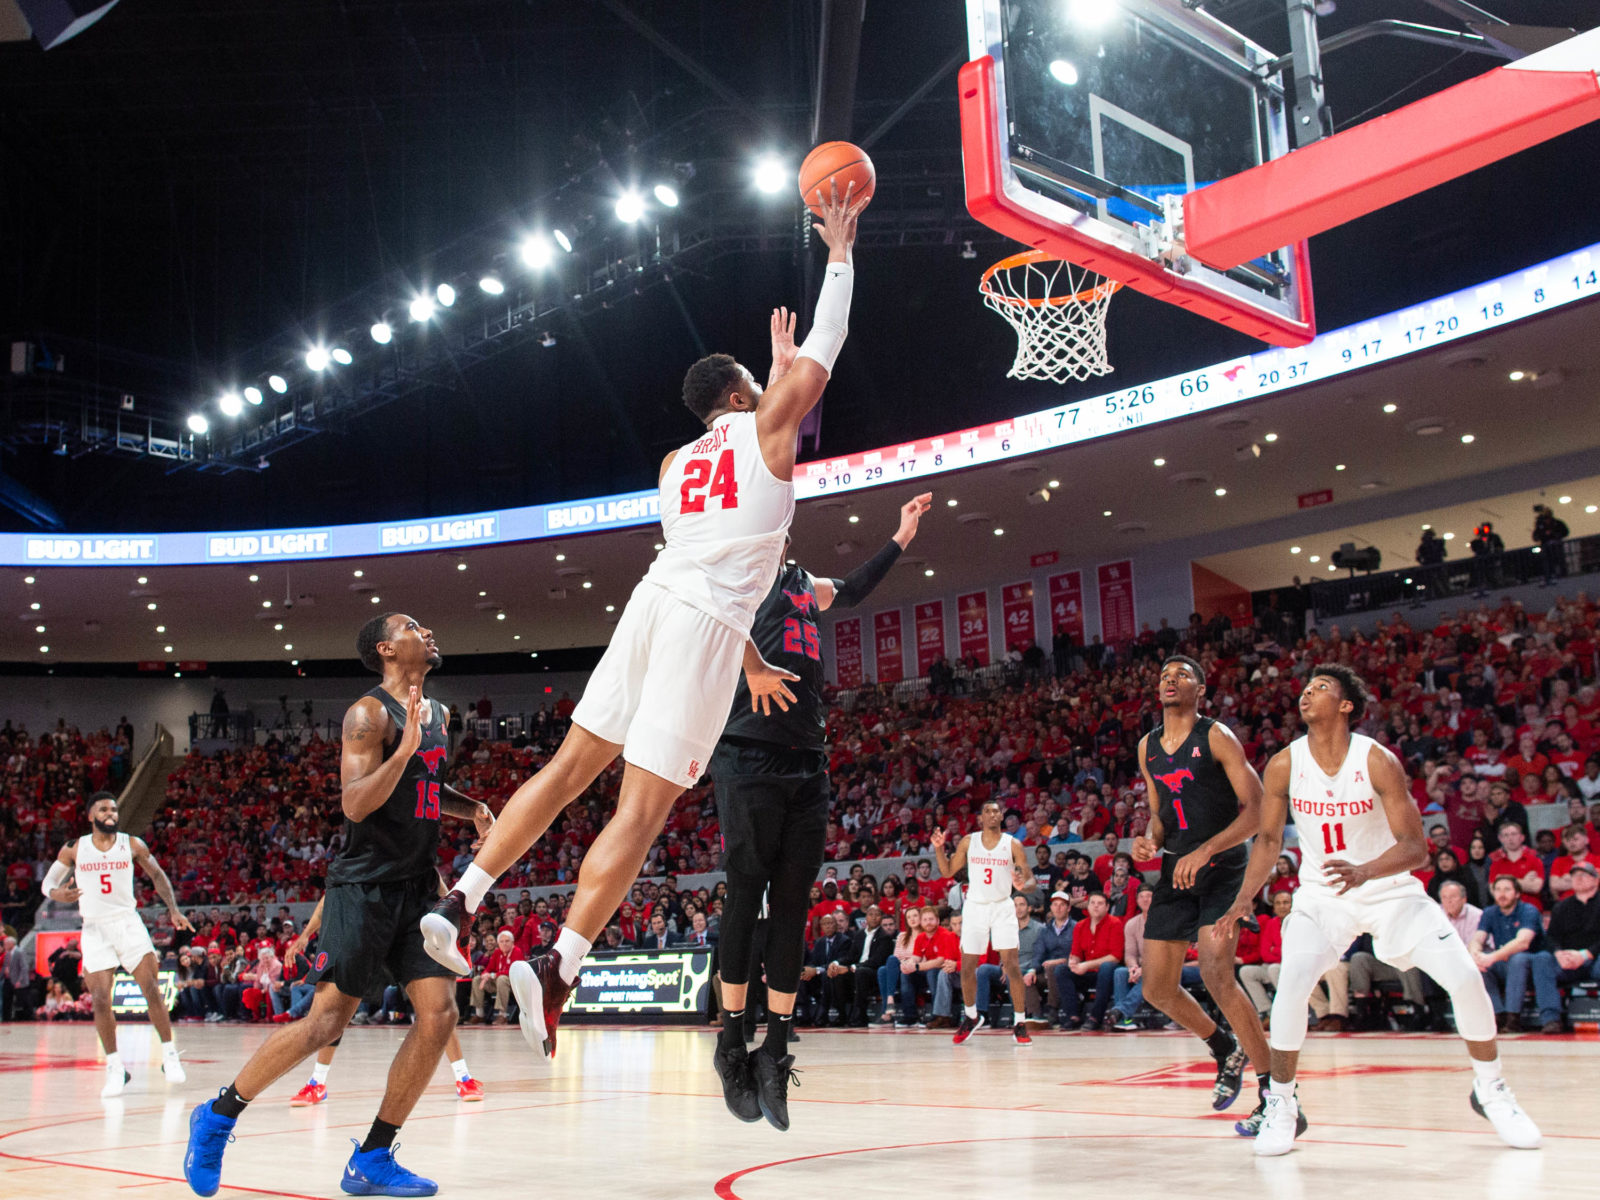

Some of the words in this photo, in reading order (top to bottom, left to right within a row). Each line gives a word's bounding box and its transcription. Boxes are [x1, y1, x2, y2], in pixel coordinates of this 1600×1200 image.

[1572, 270, 1598, 290] 14
[1534, 288, 1545, 304] 8
[1480, 302, 1504, 321] 18
[1404, 325, 1426, 344] 17
[1435, 316, 1459, 335] 20
[1341, 349, 1352, 363] 9
[1361, 339, 1382, 357] 17
[1258, 370, 1280, 387] 20
[1287, 361, 1309, 379] 37
[1180, 374, 1209, 397] 66
[1105, 386, 1155, 414] 5:26
[1054, 408, 1080, 429] 77
[967, 446, 974, 459] 1
[1001, 439, 1011, 452] 6
[899, 460, 916, 473] 17
[934, 454, 943, 466] 8
[679, 449, 738, 515] 24
[818, 477, 827, 489] 9
[834, 472, 851, 486] 10
[865, 466, 883, 481] 29
[546, 505, 595, 530] BUD
[596, 495, 660, 521] LIGHT
[382, 525, 429, 548] BUD
[431, 517, 496, 542] LIGHT
[27, 539, 81, 559] BUD
[82, 539, 153, 559] LIGHT
[210, 536, 260, 557] BUD
[261, 532, 328, 555] LIGHT
[1008, 610, 1030, 625] 42
[1055, 600, 1078, 616] 44
[921, 628, 940, 642] 22
[963, 618, 984, 634] 34
[783, 617, 821, 661] 25
[880, 636, 897, 651] 10
[415, 780, 440, 820] 15
[1292, 798, 1374, 817] HOUSTON
[1172, 799, 1188, 830] 1
[1321, 822, 1347, 854] 11
[80, 861, 129, 872] HOUSTON
[971, 856, 1009, 866] HOUSTON
[100, 874, 112, 894] 5
[983, 868, 993, 885] 3
